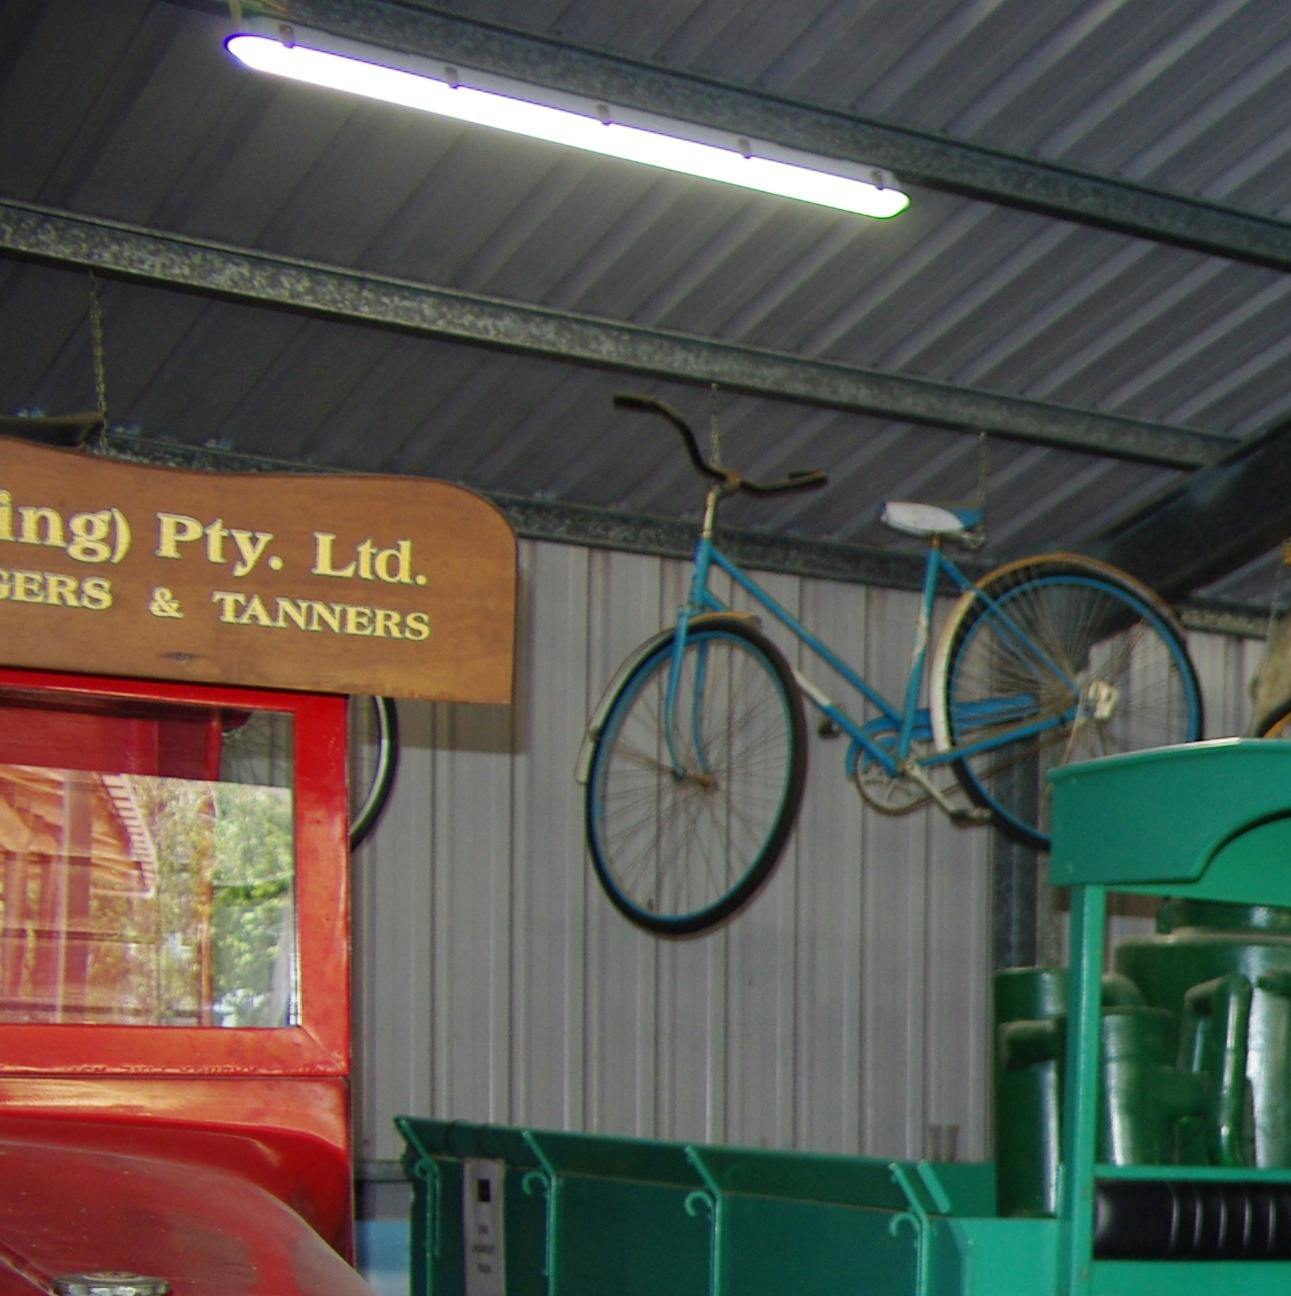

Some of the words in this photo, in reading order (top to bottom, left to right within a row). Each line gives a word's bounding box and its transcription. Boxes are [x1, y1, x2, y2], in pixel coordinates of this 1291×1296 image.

[155, 512, 285, 577] Pty.
[312, 532, 429, 586] Ltd.
[149, 586, 184, 620] &
[212, 590, 431, 642] TANNERS
